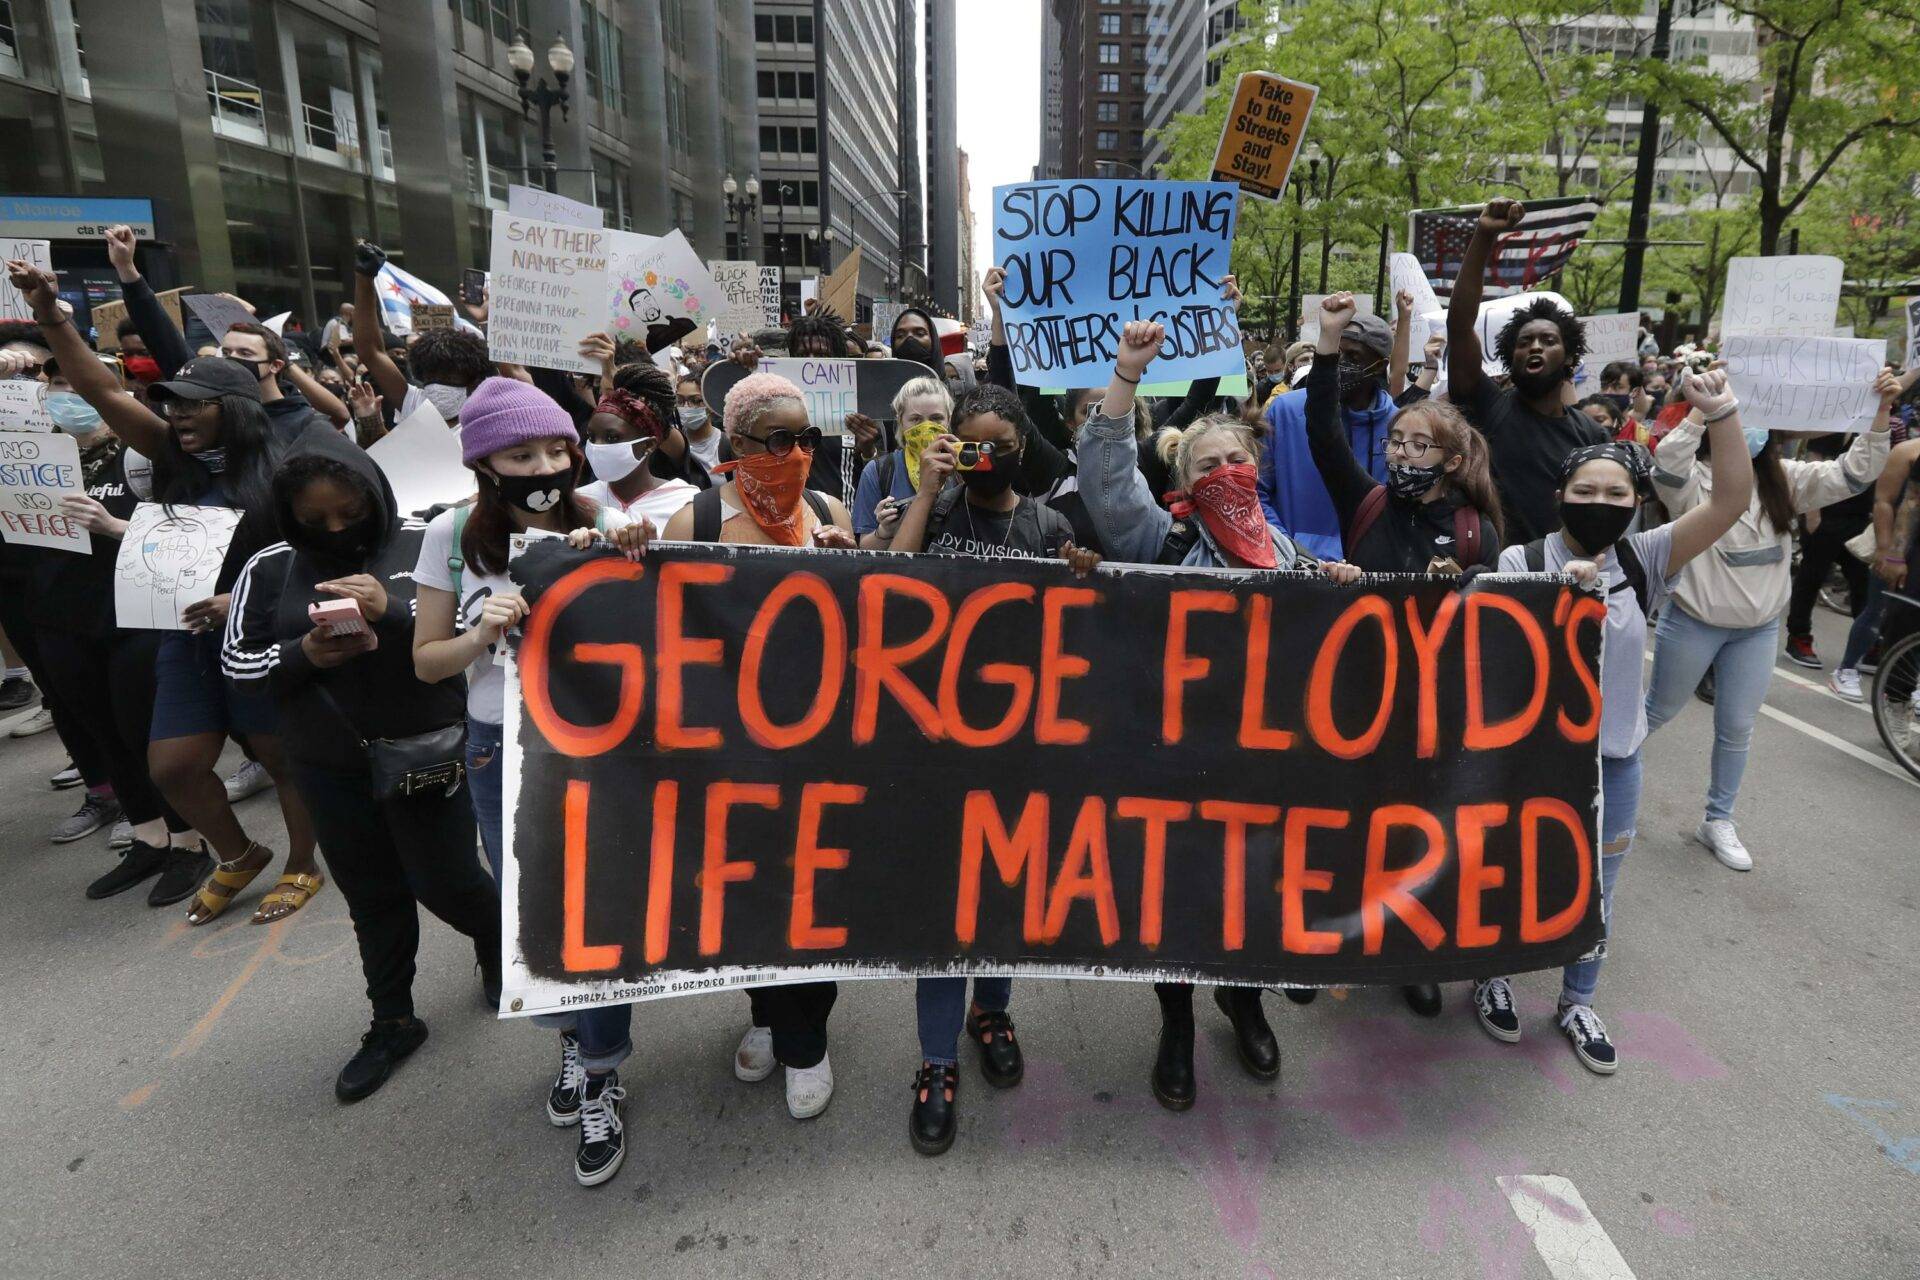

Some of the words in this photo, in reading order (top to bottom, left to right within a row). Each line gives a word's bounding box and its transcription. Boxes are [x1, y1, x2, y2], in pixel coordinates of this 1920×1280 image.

[1258, 79, 1293, 105] Take
[1247, 96, 1262, 116] to
[1266, 103, 1292, 126] the
[1235, 114, 1290, 146] Streets
[1242, 140, 1273, 161] and
[1231, 153, 1272, 180] Stay!
[997, 184, 1101, 241] STOP
[1113, 185, 1233, 240] KILLING
[77, 225, 94, 235] cta
[506, 221, 547, 248] SAY
[551, 227, 602, 255] THEIR
[512, 249, 575, 275] NAMES
[499, 275, 538, 294] GEORGE
[541, 281, 570, 298] FLOYD
[714, 268, 748, 282] BLACK
[721, 280, 746, 293] IVES
[1000, 249, 1076, 309] OUR
[1108, 242, 1220, 301] BLACK
[727, 289, 762, 305] ATTER
[760, 287, 779, 295] TIONS
[762, 295, 779, 304] TICE
[496, 296, 541, 315] BREONNA
[544, 304, 579, 319] TAYLOR
[491, 331, 517, 348] TONY
[1005, 312, 1121, 373] BROTHERS
[1152, 304, 1241, 361] SISTERS
[1726, 338, 1807, 381] BLACK
[1814, 340, 1881, 383] LIVES
[802, 361, 855, 387] CAN'T
[804, 390, 855, 433] ATHE
[1, 440, 40, 460] NO
[0, 462, 75, 487] STICE
[15, 492, 53, 511] NO
[1, 510, 80, 540] PEACE
[965, 539, 1035, 560] DIVISION
[518, 557, 1099, 758] GEORGE
[1162, 585, 1607, 759] FLOYD'S
[561, 779, 868, 973] LIFE
[954, 788, 1592, 955] MATTERED
[613, 984, 665, 998] 400565534
[671, 977, 725, 990] 03/04/2019
[560, 991, 607, 1005] 74786415
